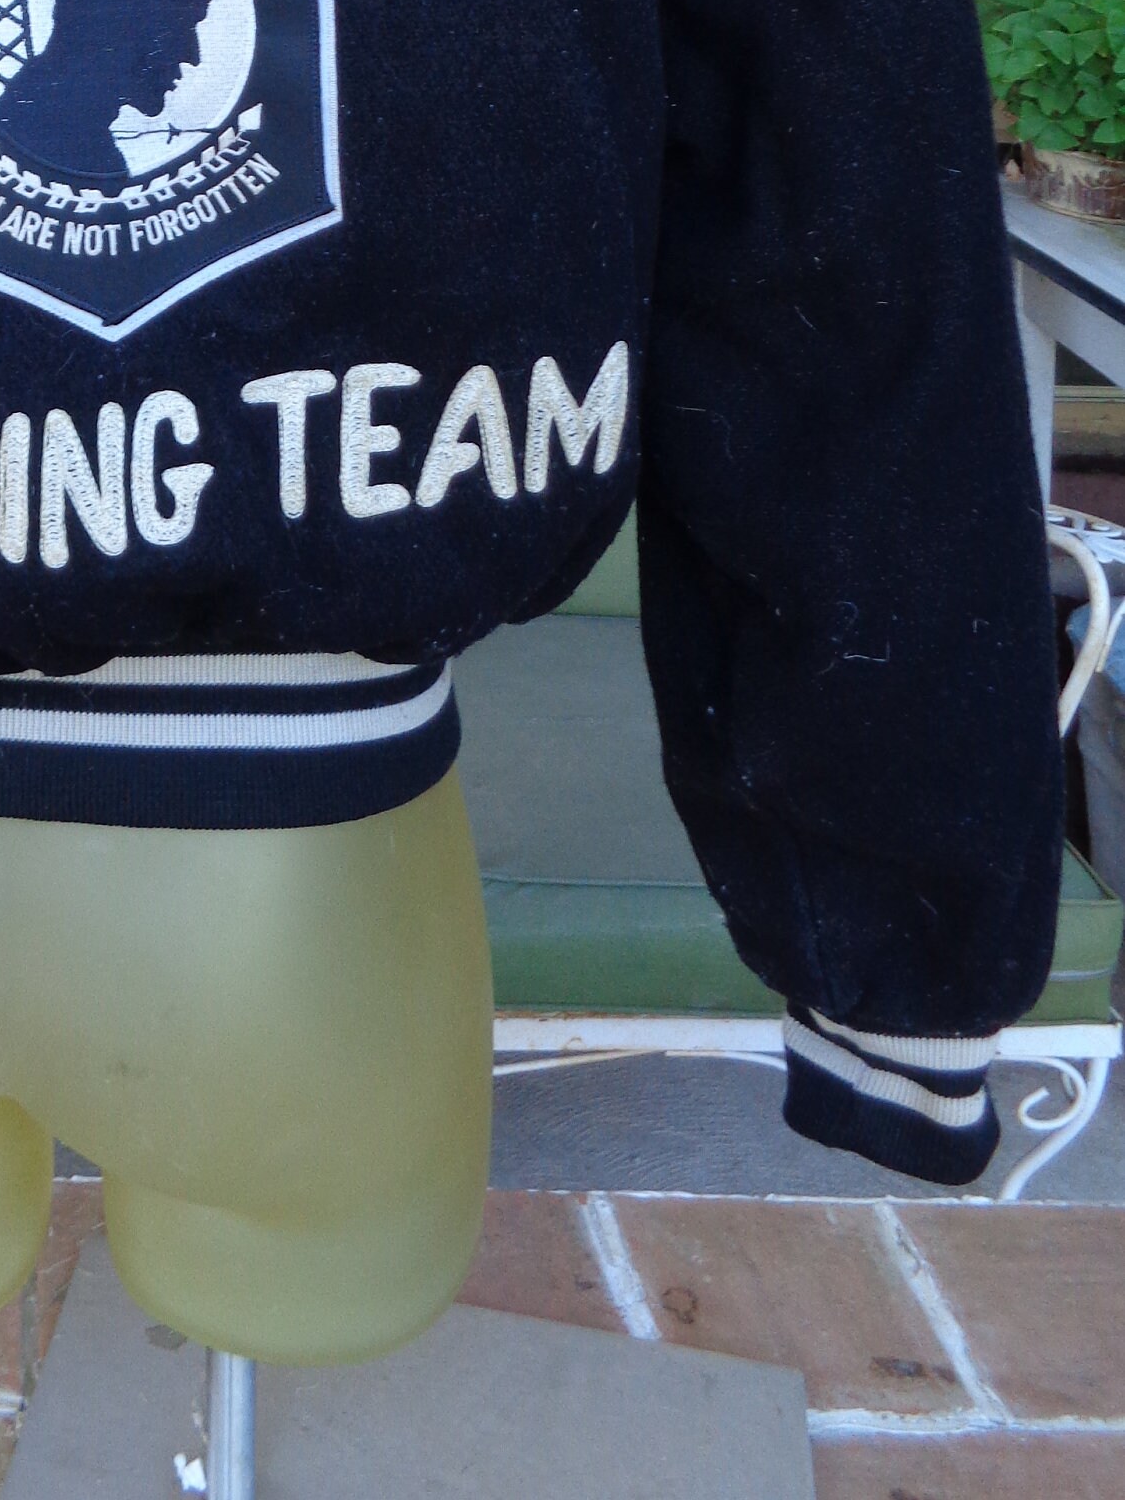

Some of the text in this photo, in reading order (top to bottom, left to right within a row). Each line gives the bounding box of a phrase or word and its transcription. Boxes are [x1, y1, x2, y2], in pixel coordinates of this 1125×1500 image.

[61, 219, 122, 257] NOT
[128, 152, 281, 252] FORGOTTEN
[240, 340, 629, 520] TEAM
